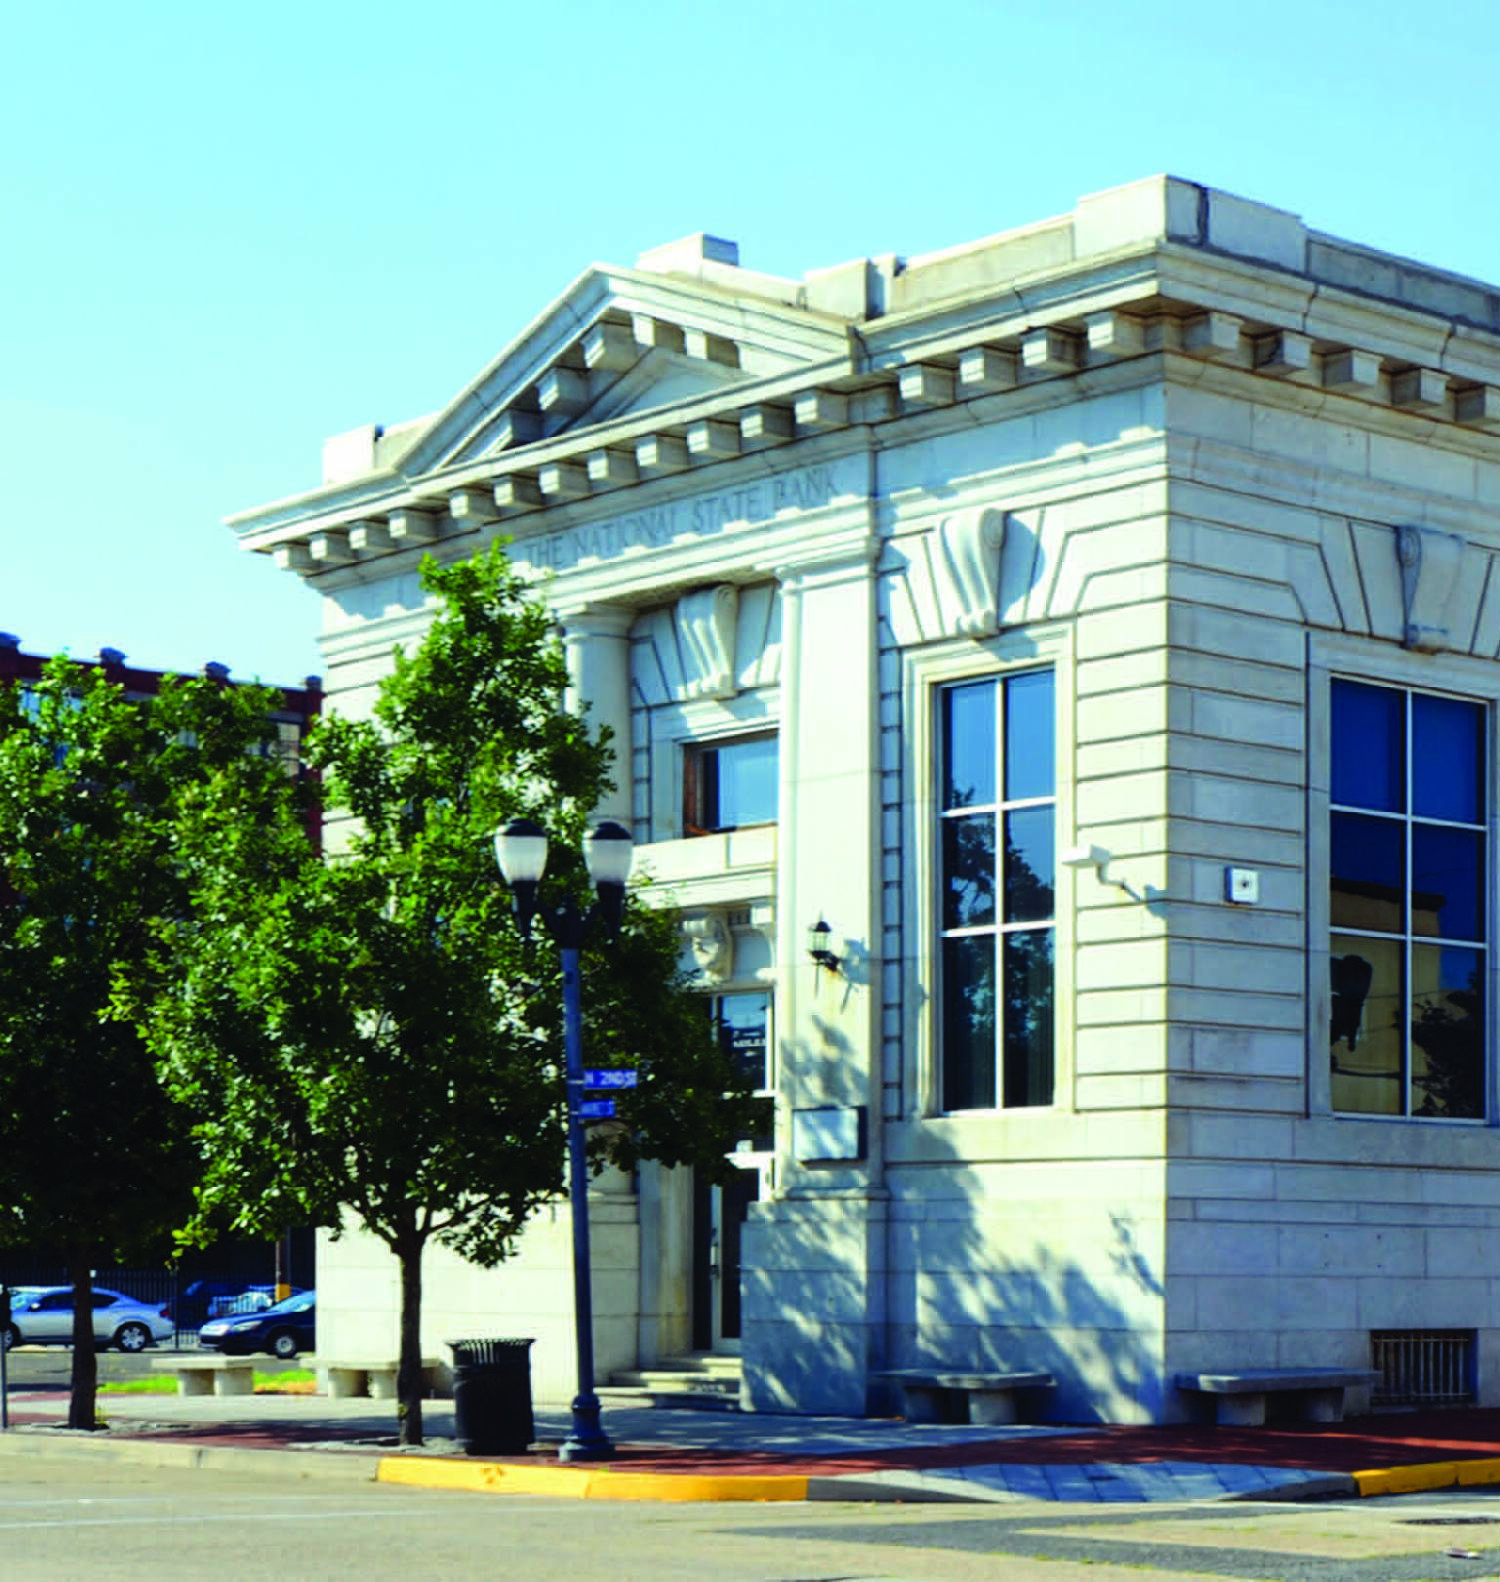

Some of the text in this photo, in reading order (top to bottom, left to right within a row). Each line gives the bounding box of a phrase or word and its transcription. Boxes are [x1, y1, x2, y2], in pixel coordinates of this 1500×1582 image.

[524, 466, 838, 566] THE NATIONAL STATE BANK
